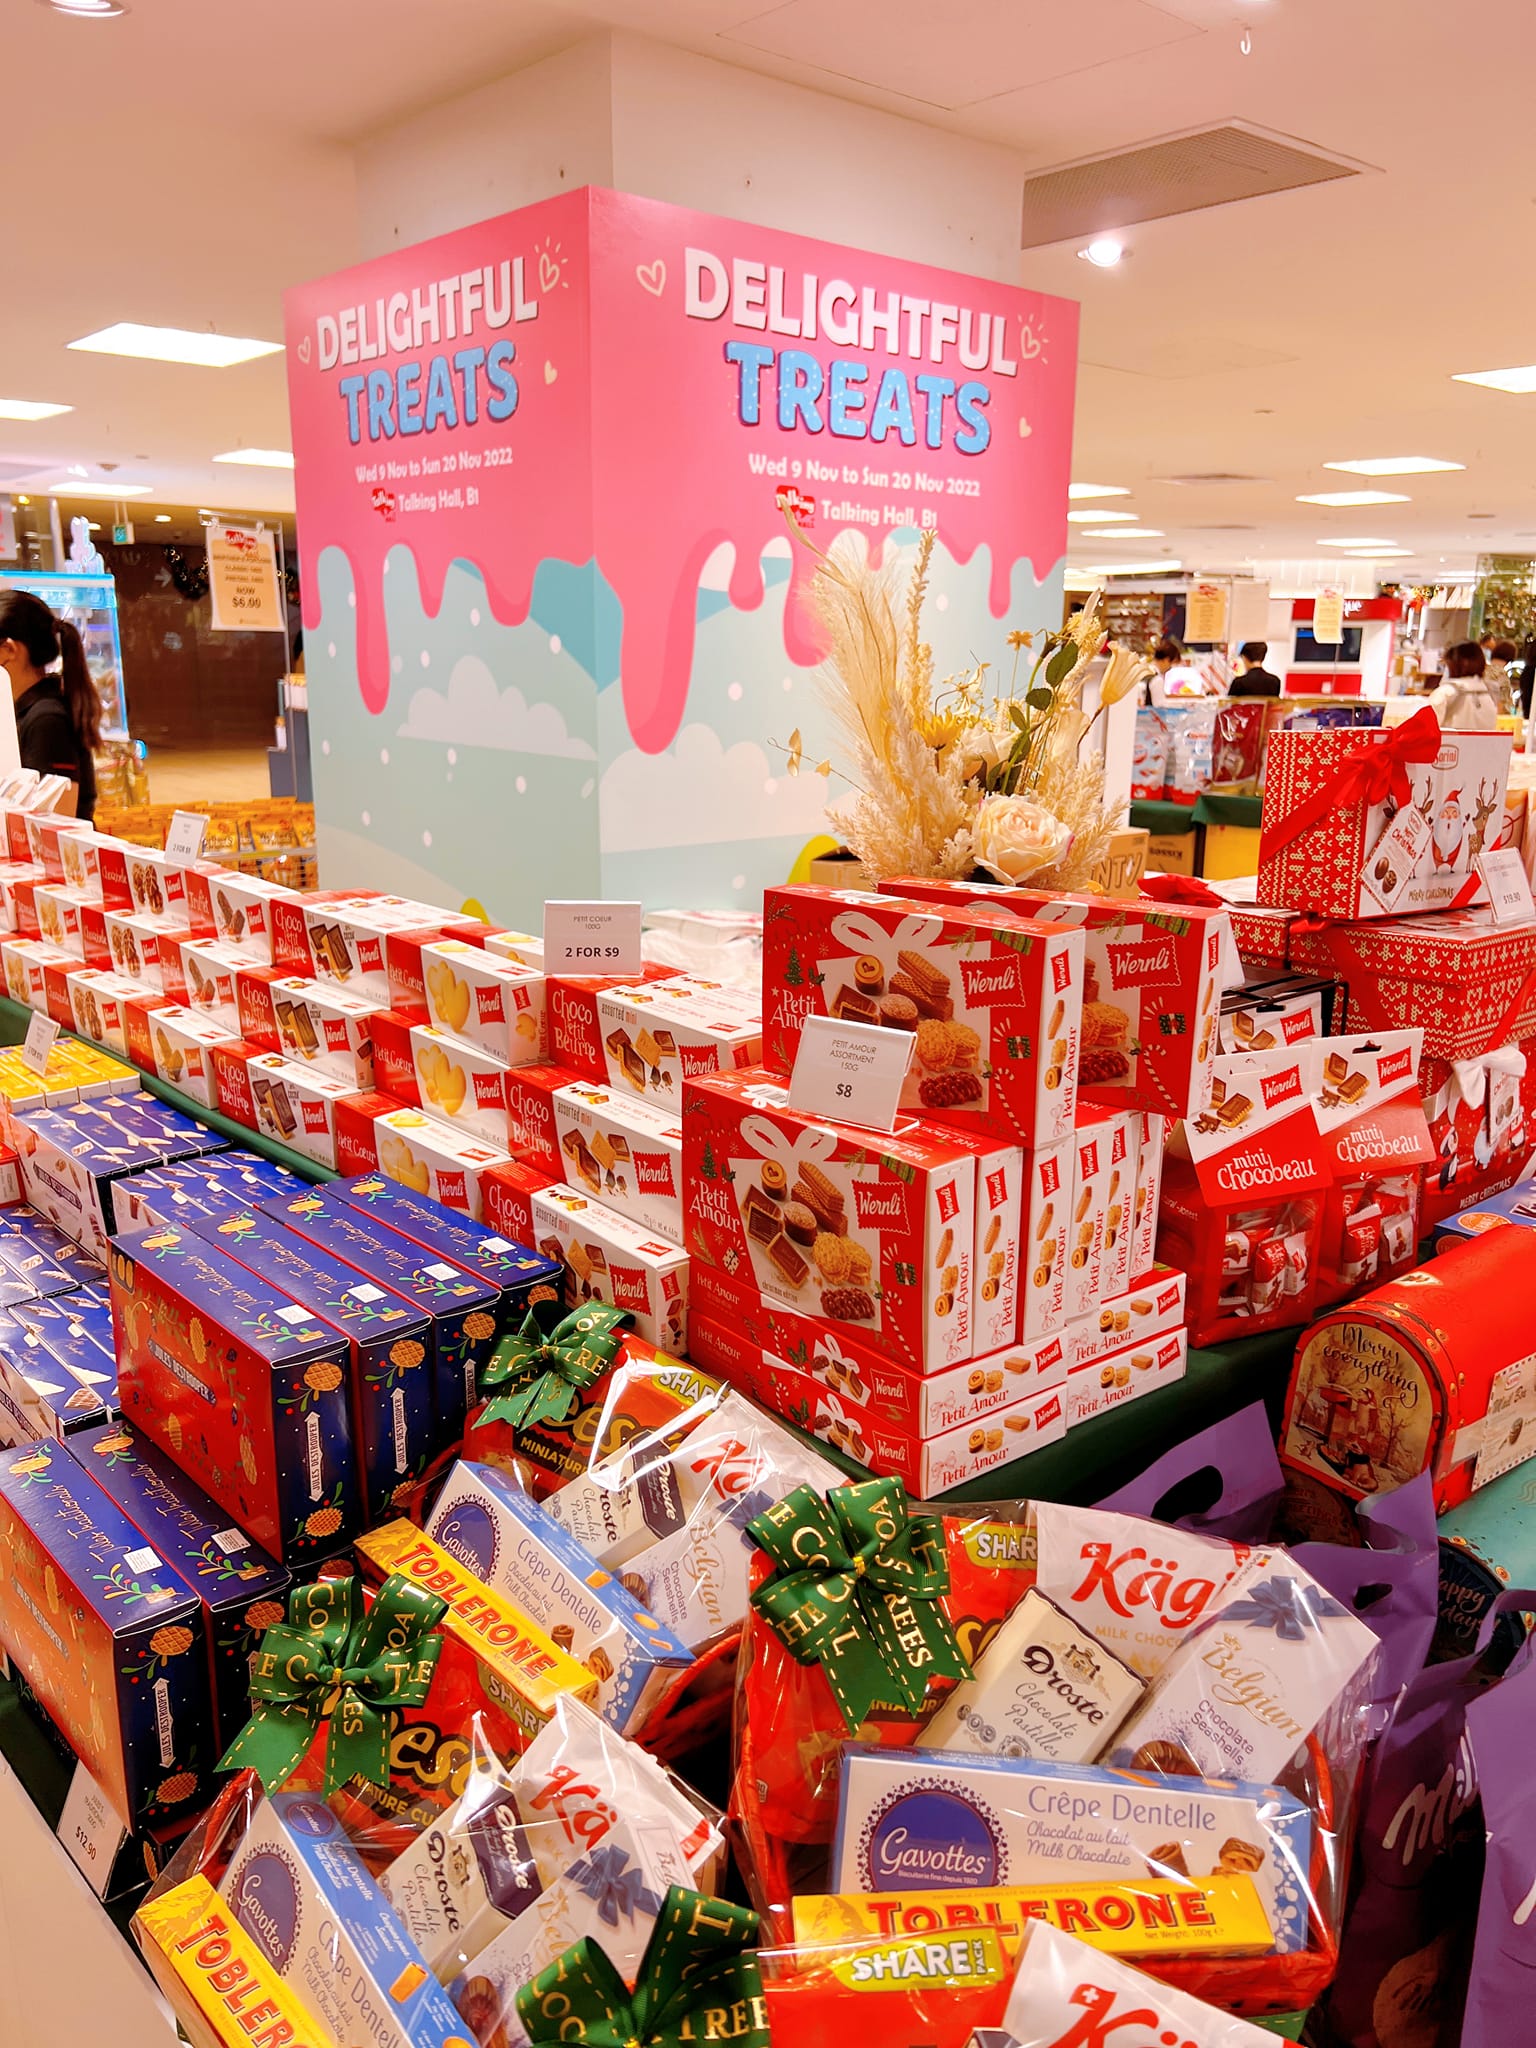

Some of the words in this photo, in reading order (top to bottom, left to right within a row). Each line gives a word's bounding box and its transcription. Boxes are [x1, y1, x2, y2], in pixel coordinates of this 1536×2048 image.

[316, 256, 538, 372] DELIGHTFUL
[684, 247, 1018, 377] DELIGHTFUL
[340, 339, 519, 445] TREATS
[724, 340, 992, 455] TREATS
[355, 463, 377, 483] Wed
[379, 467, 386, 480] 9
[387, 462, 407, 479] Nov
[409, 461, 420, 477] to
[422, 457, 441, 475] Sun
[442, 455, 457, 472] 20
[458, 451, 482, 470] Nov
[484, 448, 513, 467] 2022
[748, 453, 787, 477] Wed
[791, 460, 802, 478] 9
[806, 459, 839, 482] Nov
[842, 466, 859, 485] to
[862, 466, 889, 489] Sun
[892, 471, 911, 490] 20
[914, 472, 944, 494] Nov
[946, 477, 981, 497] 2022
[398, 493, 436, 512] Talking
[821, 500, 880, 526] Talking
[883, 506, 918, 528] Hall,
[922, 508, 938, 527] B1
[275, 906, 302, 931] Choco
[573, 915, 589, 923] PETIT
[589, 915, 612, 923] COEUR
[565, 947, 573, 958] 2
[576, 947, 601, 957] FOR
[605, 947, 620, 959] $9
[1114, 947, 1170, 977] Wernli
[242, 982, 269, 1008] Choco
[966, 963, 1016, 995] Wernli
[552, 988, 593, 1025] Choco
[601, 1003, 625, 1022] assorted
[782, 989, 817, 1014] Petit
[554, 1027, 596, 1064] Beurre
[829, 1049, 875, 1064] ASSORTMENT
[831, 1038, 849, 1051] PETIT
[849, 1043, 877, 1055] AMOUR
[1063, 1026, 1077, 1081] Amour
[218, 1056, 246, 1084] Choco
[840, 1061, 859, 1072] 150G
[1380, 1053, 1409, 1077] Wernli
[509, 1084, 549, 1122] Choco
[836, 1082, 853, 1099] $8
[1063, 1081, 1073, 1118] Petit
[1265, 1073, 1297, 1100] Wernli
[558, 1101, 580, 1121] assorted
[580, 1111, 593, 1127] mini
[511, 1121, 553, 1162] Beurre
[1336, 1135, 1422, 1163] Chocobeau
[1350, 1124, 1383, 1144] mini
[637, 1158, 669, 1183] Wernli
[1217, 1157, 1317, 1191] Chocobeau
[1234, 1148, 1273, 1170] mini
[489, 1186, 528, 1225] Choco
[688, 1196, 740, 1234] Amour
[697, 1180, 729, 1214] Petit
[858, 1190, 902, 1217] Wernli
[535, 1206, 558, 1228] assorted
[558, 1216, 570, 1235] mini
[1002, 1238, 1015, 1291] Amour
[1053, 1226, 1067, 1278] Amour
[613, 1275, 645, 1298] Wernli
[957, 1252, 969, 1305] Amour
[1052, 1279, 1063, 1314] Petit
[957, 1306, 969, 1342] Petit
[1002, 1291, 1013, 1328] Petit
[1075, 1345, 1097, 1362] Petit
[1100, 1329, 1135, 1351] Amour
[1342, 1323, 1400, 1367] Merry
[172, 1361, 210, 1398] DESTROOPER
[876, 1380, 904, 1399] Wernli
[1323, 1345, 1418, 1409] everything
[941, 1404, 966, 1427] Petit
[969, 1390, 1009, 1415] Amour
[1077, 1400, 1099, 1418] Petit
[1100, 1385, 1135, 1408] Amour
[394, 1397, 405, 1444] DESTROOPER
[309, 1422, 321, 1470] DESTROOPER
[398, 1444, 406, 1465] JULES
[877, 1441, 906, 1461] Wernli
[313, 1470, 322, 1491] JULES
[942, 1464, 967, 1487] Petit
[968, 1448, 1009, 1473] Amour
[582, 1488, 597, 1543] Chocolate
[439, 1521, 485, 1578] Gavottes
[517, 1538, 551, 1582] Crêpe
[551, 1572, 602, 1635] Dentelle
[670, 1561, 687, 1620] Chocolate
[683, 1521, 723, 1625] Belgian
[391, 1542, 558, 1681] TOBLERONE
[503, 1572, 518, 1597] Milk
[517, 1590, 547, 1626] Chocolate
[662, 1567, 679, 1624] Seashells
[1094, 1626, 1129, 1641] MILK
[1023, 1645, 1109, 1726] Droste
[1200, 1642, 1304, 1741] Belgian
[158, 1688, 170, 1735] DESTROOPER
[1015, 1682, 1076, 1741] Chocolate
[1198, 1700, 1255, 1755] Chocolate
[162, 1735, 171, 1757] JULES
[1005, 1703, 1061, 1759] Pastilles
[1190, 1713, 1245, 1767] Seashells
[1028, 1785, 1101, 1821] Crêpe
[1113, 1794, 1217, 1831] Dentelle
[1382, 1725, 1481, 1866] Mil
[75, 1826, 97, 1861] $12.90
[495, 1803, 531, 1890] Droste
[880, 1827, 986, 1875] Gavottes
[1027, 1821, 1085, 1845] Chocolat
[1086, 1828, 1105, 1843] au
[1106, 1829, 1130, 1847] lait
[1027, 1838, 1063, 1858] Milk
[1066, 1844, 1131, 1866] Chocolate
[414, 1864, 441, 1935] Chocolate
[429, 1831, 465, 1934] Droste
[238, 1874, 284, 1958] Gavottes
[852, 1942, 972, 1979] SHARE
[974, 1940, 986, 1974] PACK
